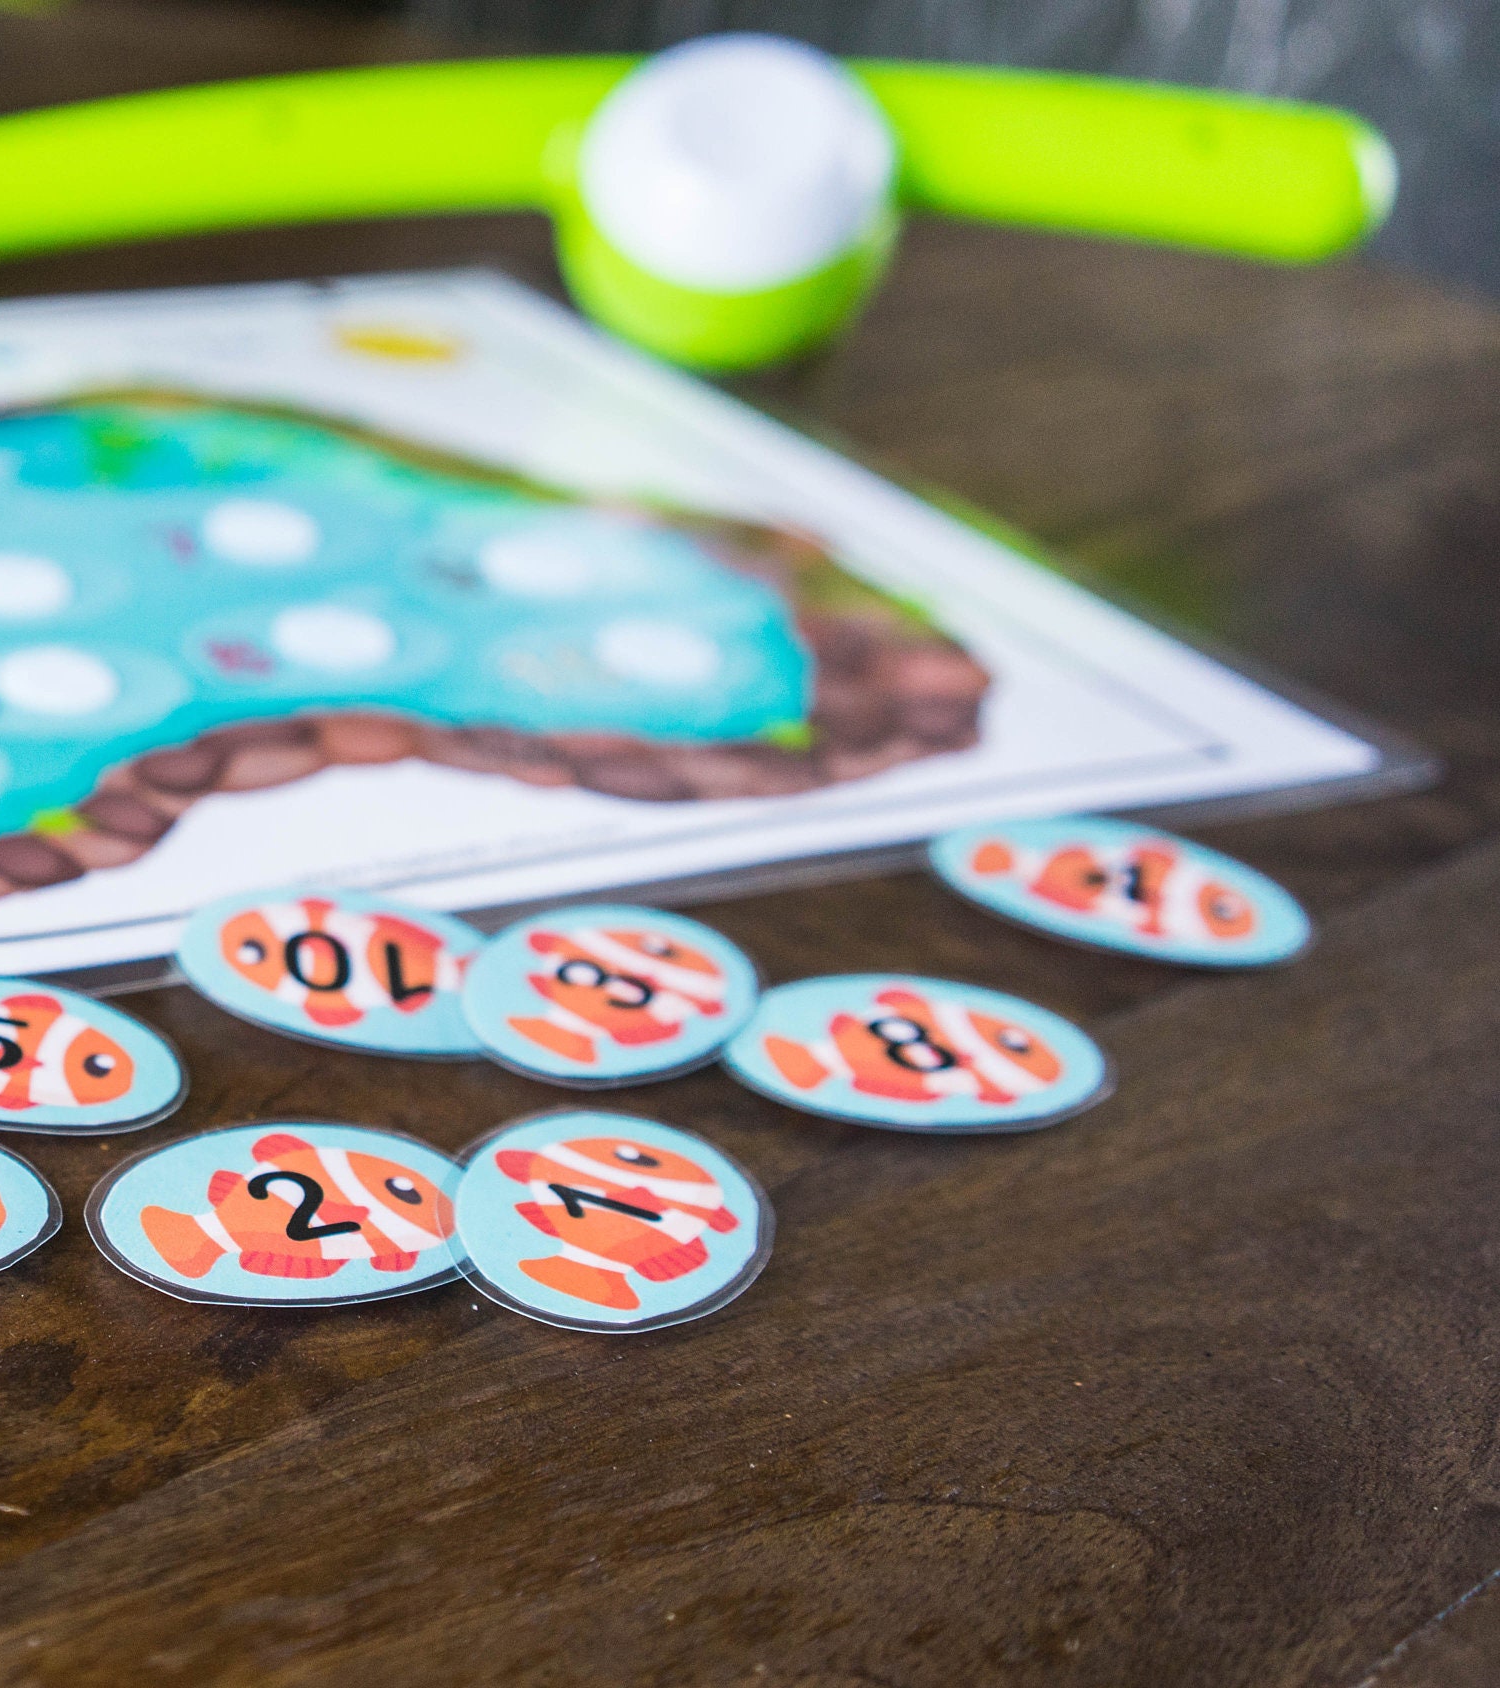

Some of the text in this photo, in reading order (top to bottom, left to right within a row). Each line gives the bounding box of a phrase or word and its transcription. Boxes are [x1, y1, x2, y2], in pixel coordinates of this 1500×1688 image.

[284, 930, 435, 1003] 10
[556, 958, 653, 1009] 3
[868, 1016, 959, 1073] 8
[246, 1170, 362, 1243] 2
[548, 1181, 661, 1222] 1
